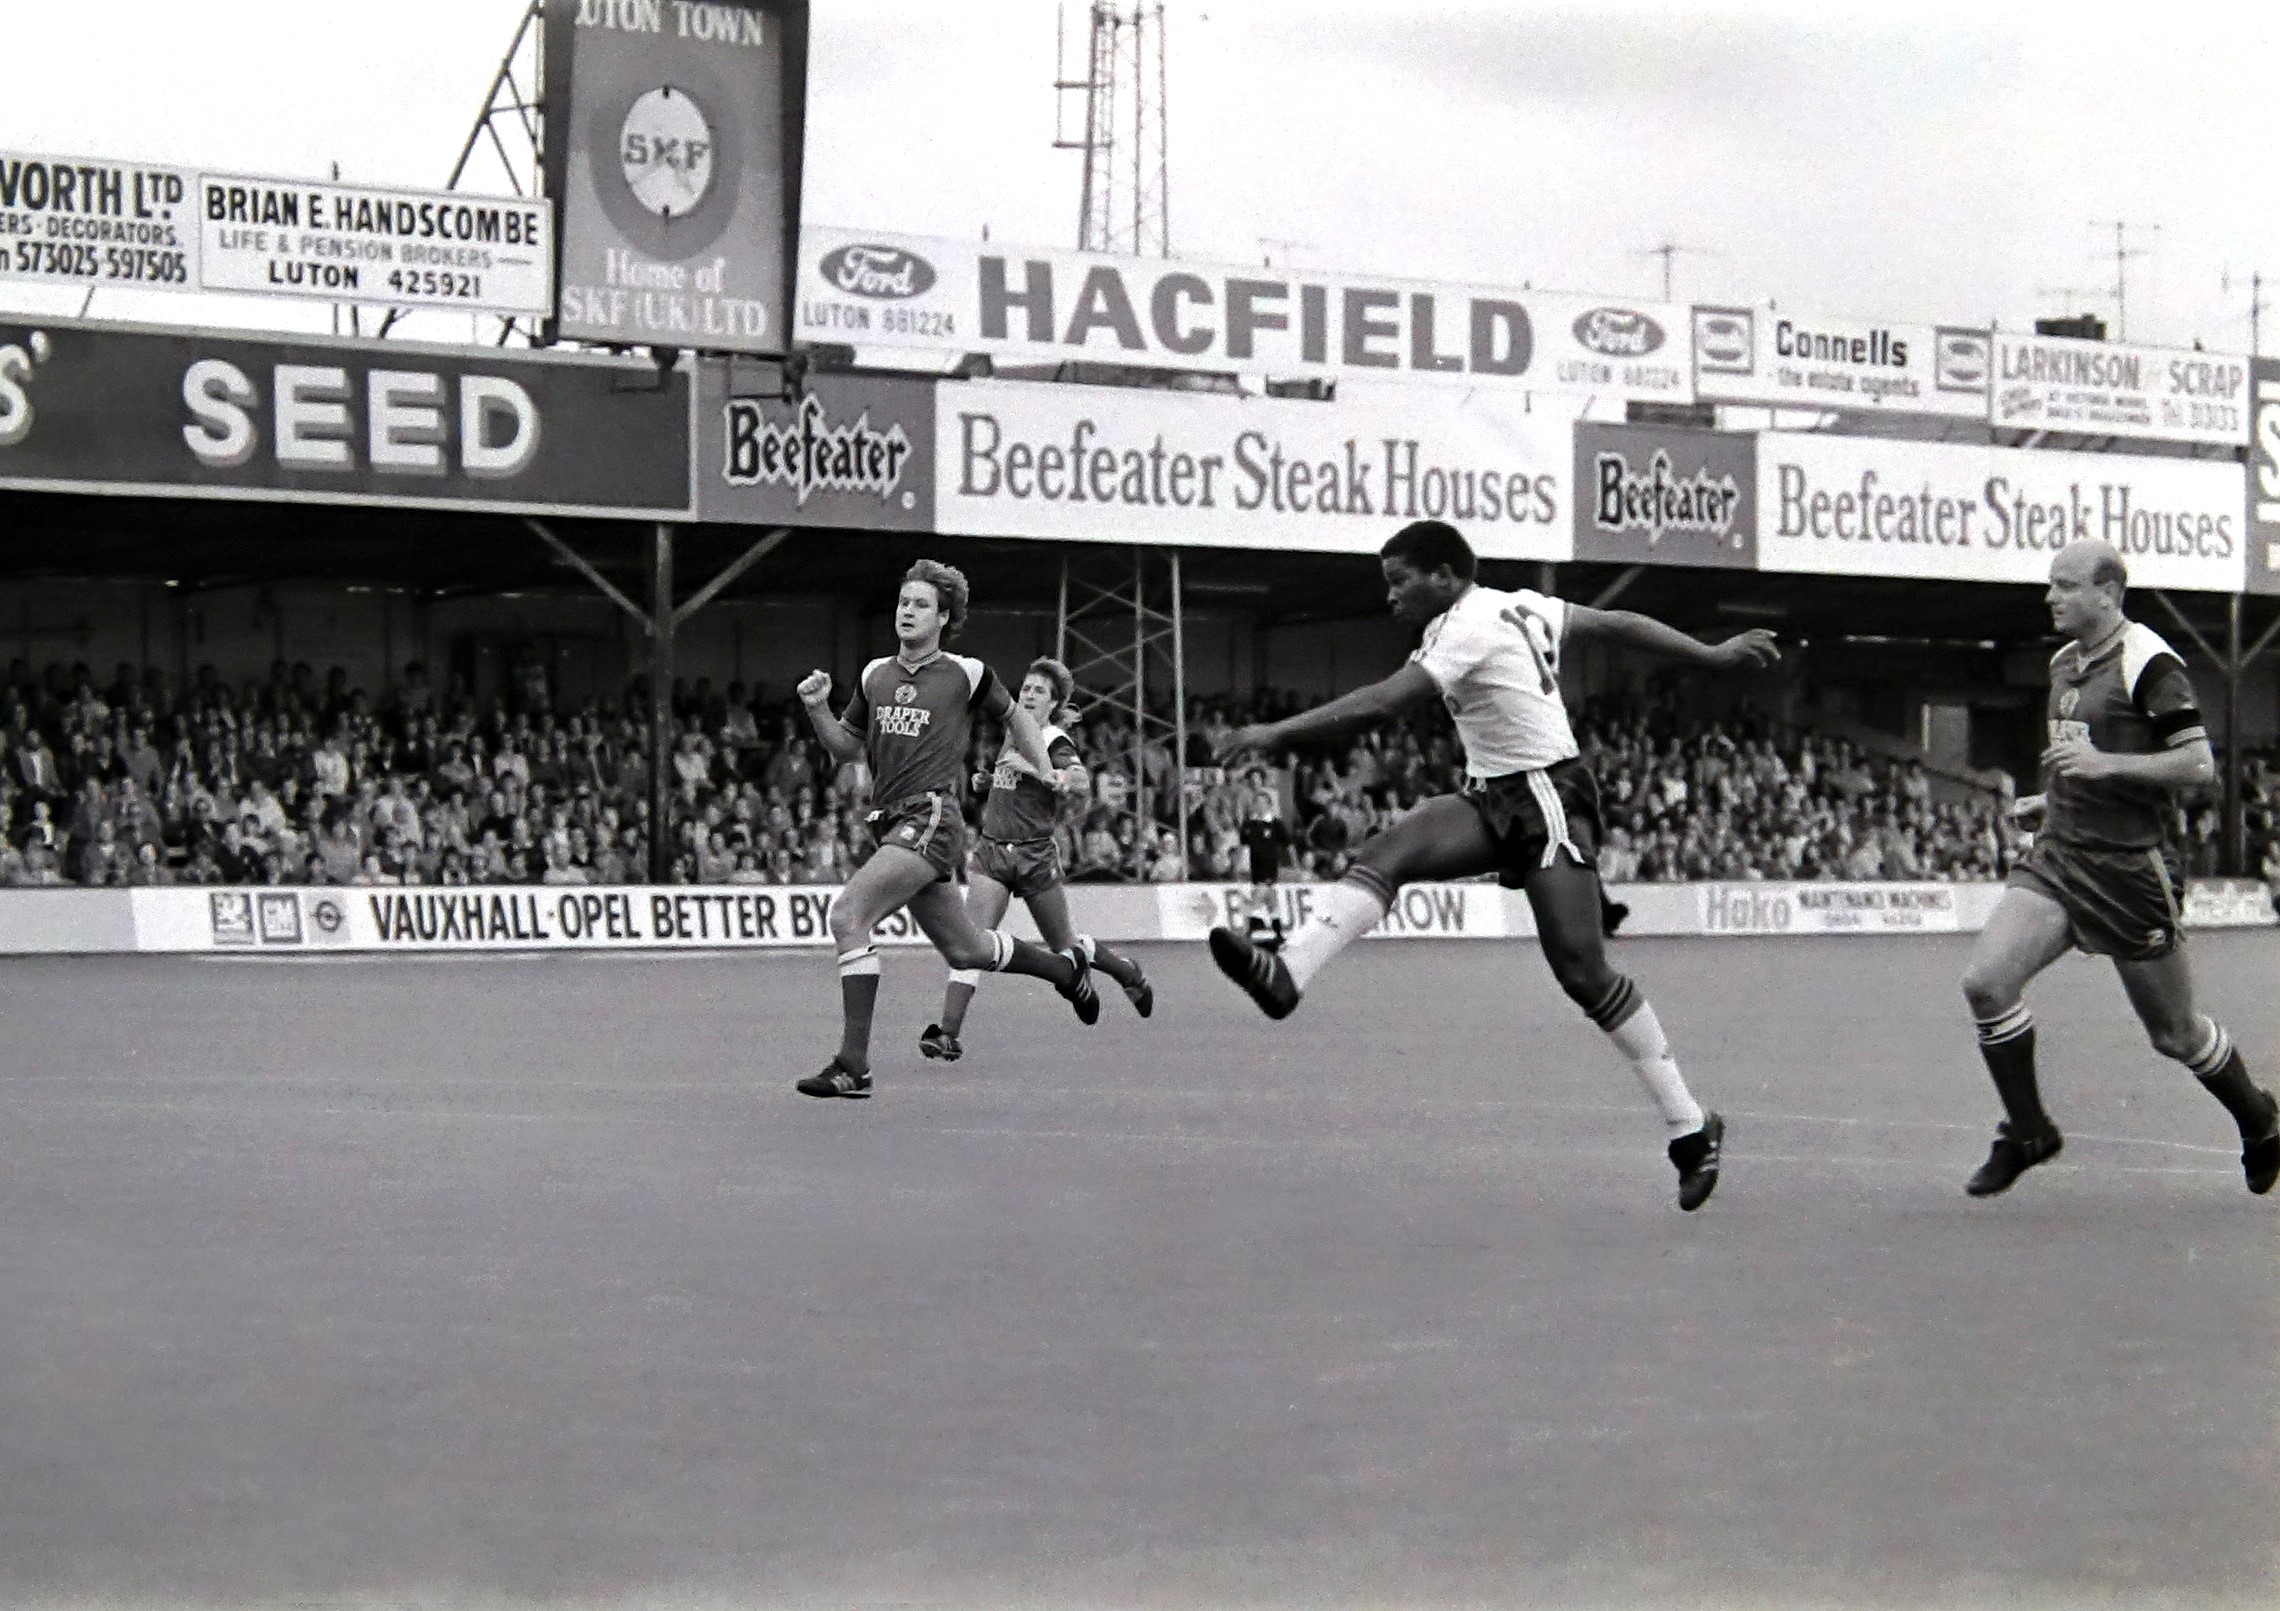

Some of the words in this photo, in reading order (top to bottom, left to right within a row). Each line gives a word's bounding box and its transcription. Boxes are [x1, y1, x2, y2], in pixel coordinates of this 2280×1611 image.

[673, 1, 763, 46] TOWN
[207, 184, 299, 226] BRIAN
[17, 241, 99, 276] 573025
[106, 247, 187, 283] 597505
[219, 229, 267, 252] LIFE
[277, 233, 289, 253] &
[301, 235, 392, 262] PENSION
[401, 244, 492, 269] BROKERS
[606, 248, 686, 289] Home
[695, 257, 726, 293] of
[836, 247, 914, 295] Ford
[268, 259, 359, 289] LUTON
[388, 269, 481, 298] 425921
[562, 284, 628, 326] SKF
[704, 297, 769, 338] LTD
[803, 301, 870, 330] LUTON
[978, 255, 1535, 377] HACFIELD
[1776, 320, 1908, 367] Connells
[2169, 360, 2244, 399] SCRAP
[182, 357, 541, 479] SEED
[726, 396, 909, 496] Beefeater
[957, 411, 1224, 509] Beefeater
[1233, 430, 1374, 516] Steak
[1382, 438, 1558, 524] Houses
[1596, 454, 1739, 530] Beefeater
[1776, 464, 1977, 546] Beefeater
[1984, 476, 2092, 551] Steak
[2100, 484, 2234, 558] Houses
[875, 706, 931, 725] DRAPER
[880, 719, 921, 737] TOOLS
[651, 894, 778, 939] BETTER
[789, 894, 832, 938] BY
